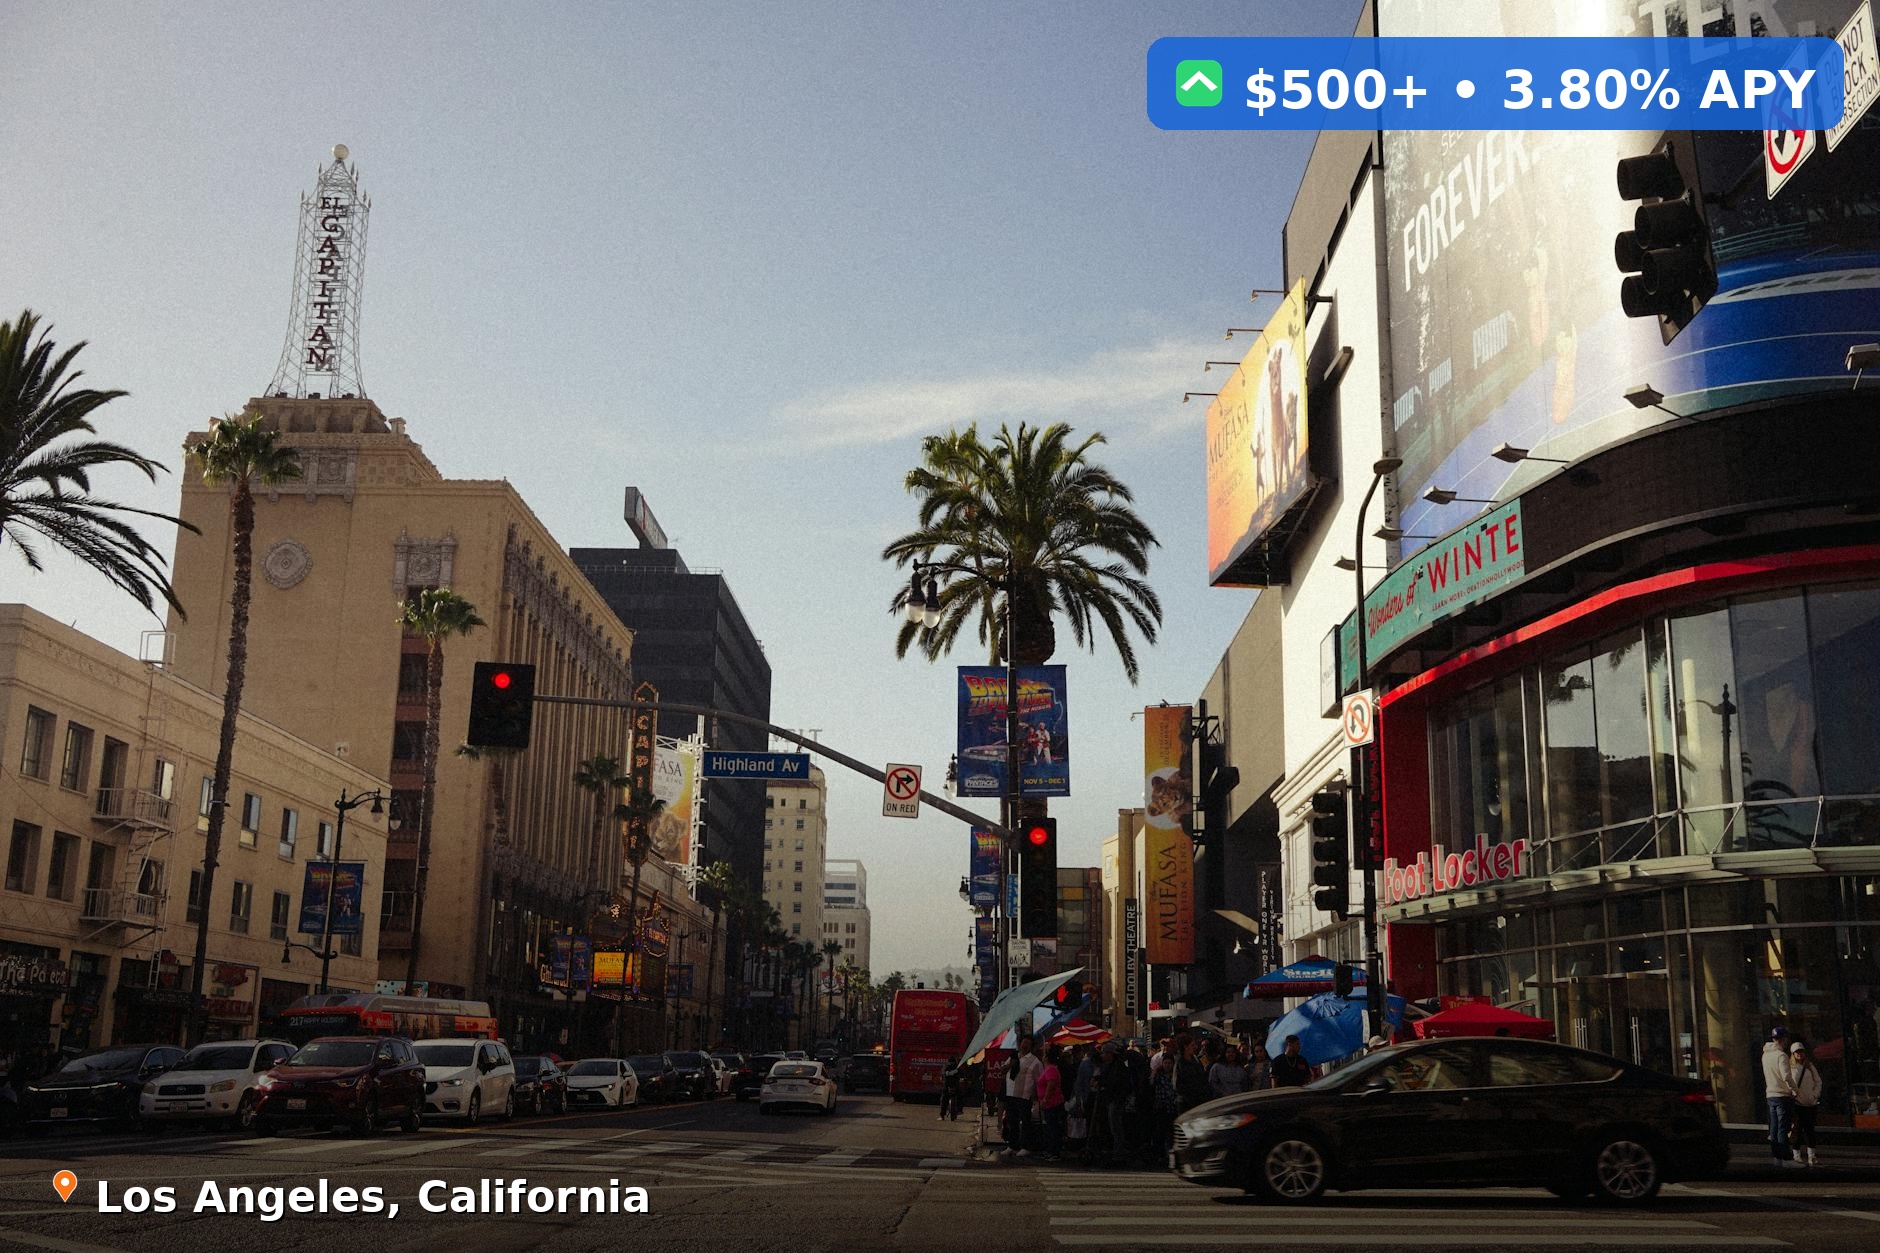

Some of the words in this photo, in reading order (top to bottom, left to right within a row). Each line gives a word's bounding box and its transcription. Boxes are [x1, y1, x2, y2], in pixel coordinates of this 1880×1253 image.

[1843, 17, 1863, 62] NOT
[321, 196, 343, 210] EL
[306, 216, 339, 365] CAPITAN
[1209, 402, 1249, 464] MUFASA
[1368, 592, 1404, 639] Wonders
[1427, 514, 1519, 593] WINTE
[712, 757, 774, 774] Highland
[782, 759, 800, 773] Av
[1049, 777, 1061, 785] DEC
[886, 803, 897, 812] ON
[900, 804, 916, 813] RED
[1160, 842, 1178, 941] MUFASA
[1384, 851, 1428, 904] Foot
[1432, 833, 1528, 892] Locker
[1127, 904, 1136, 951] THEATRE
